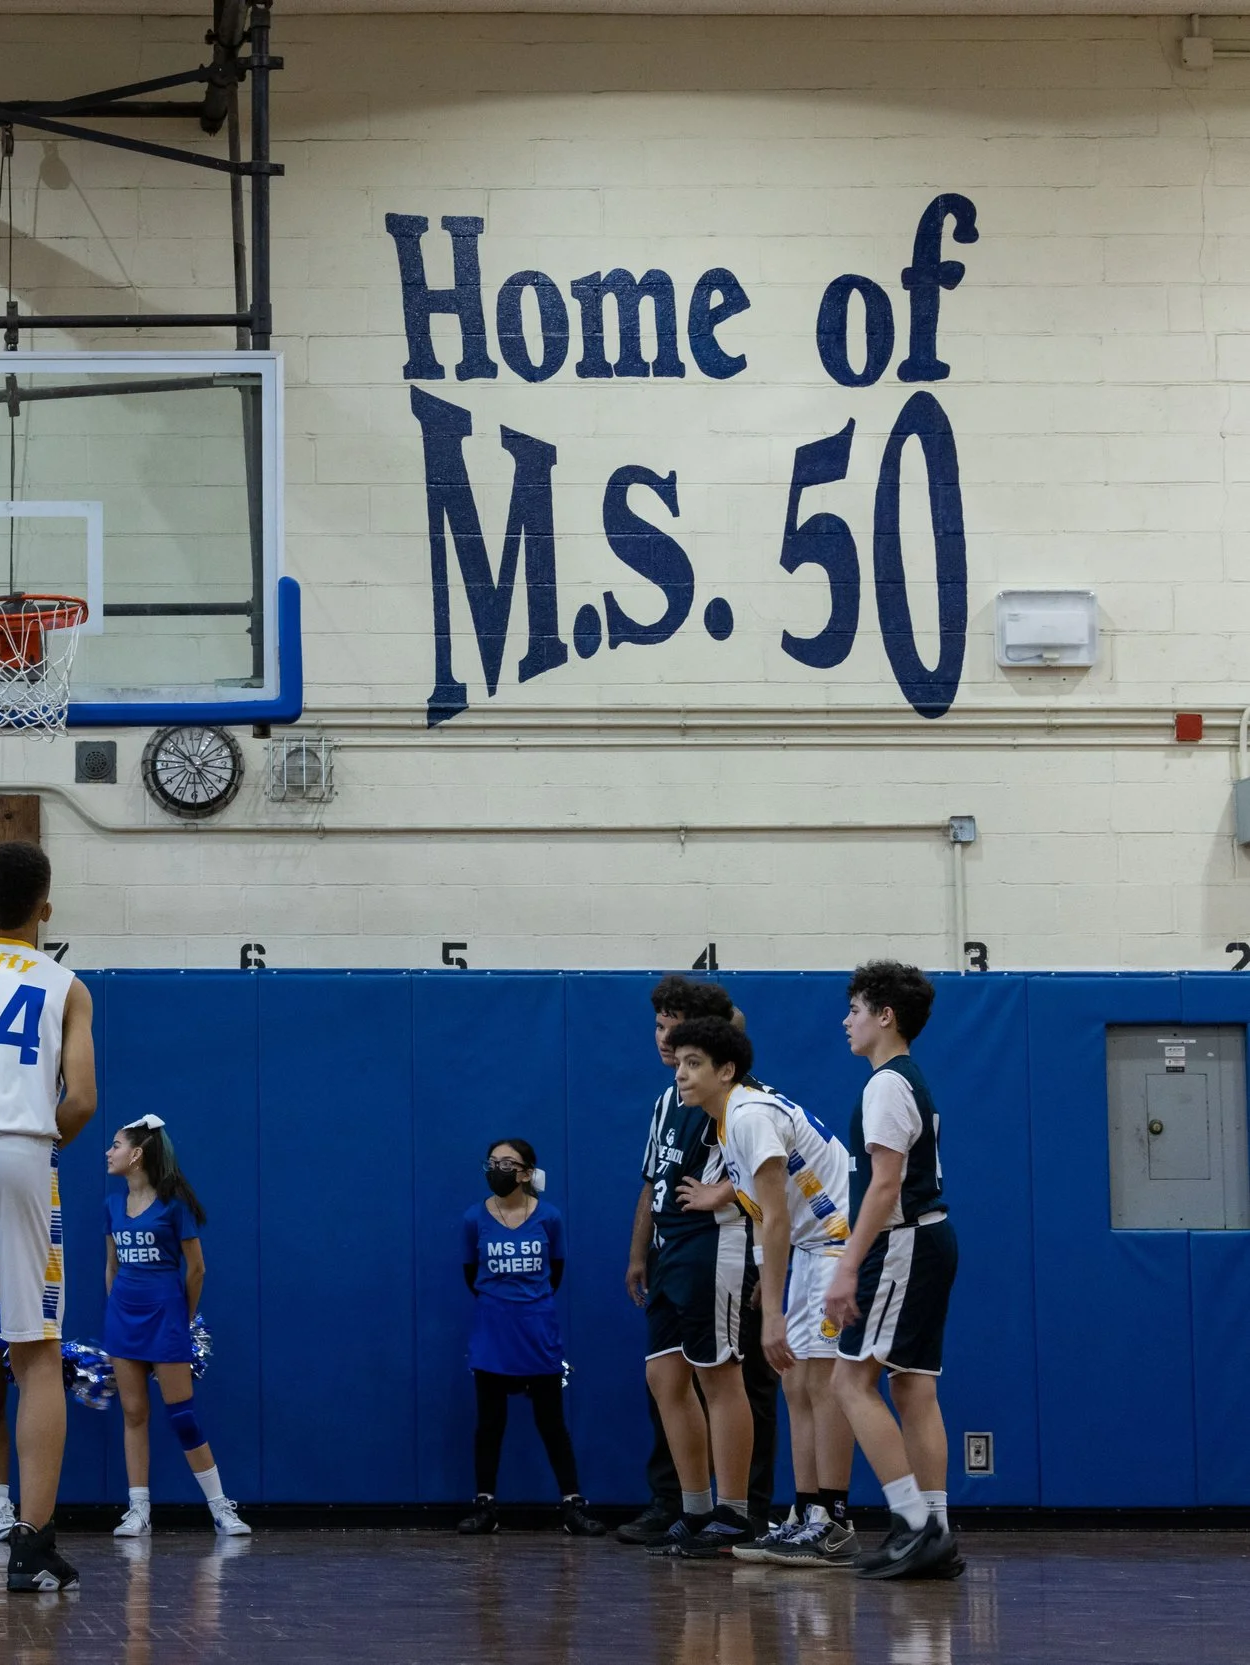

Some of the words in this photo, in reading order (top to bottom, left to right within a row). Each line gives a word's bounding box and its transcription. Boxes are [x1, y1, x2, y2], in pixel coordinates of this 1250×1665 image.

[385, 213, 751, 382] Home
[816, 193, 979, 387] of
[779, 390, 968, 718] 50
[44, 942, 69, 965] 7
[442, 942, 468, 969] 5
[691, 943, 719, 970] 4
[963, 941, 988, 971] 3
[1225, 942, 1250, 971] 2
[135, 1231, 155, 1246] 50
[487, 1241, 516, 1257] MS
[520, 1240, 542, 1255] 50
[487, 1257, 543, 1273] CHEER
